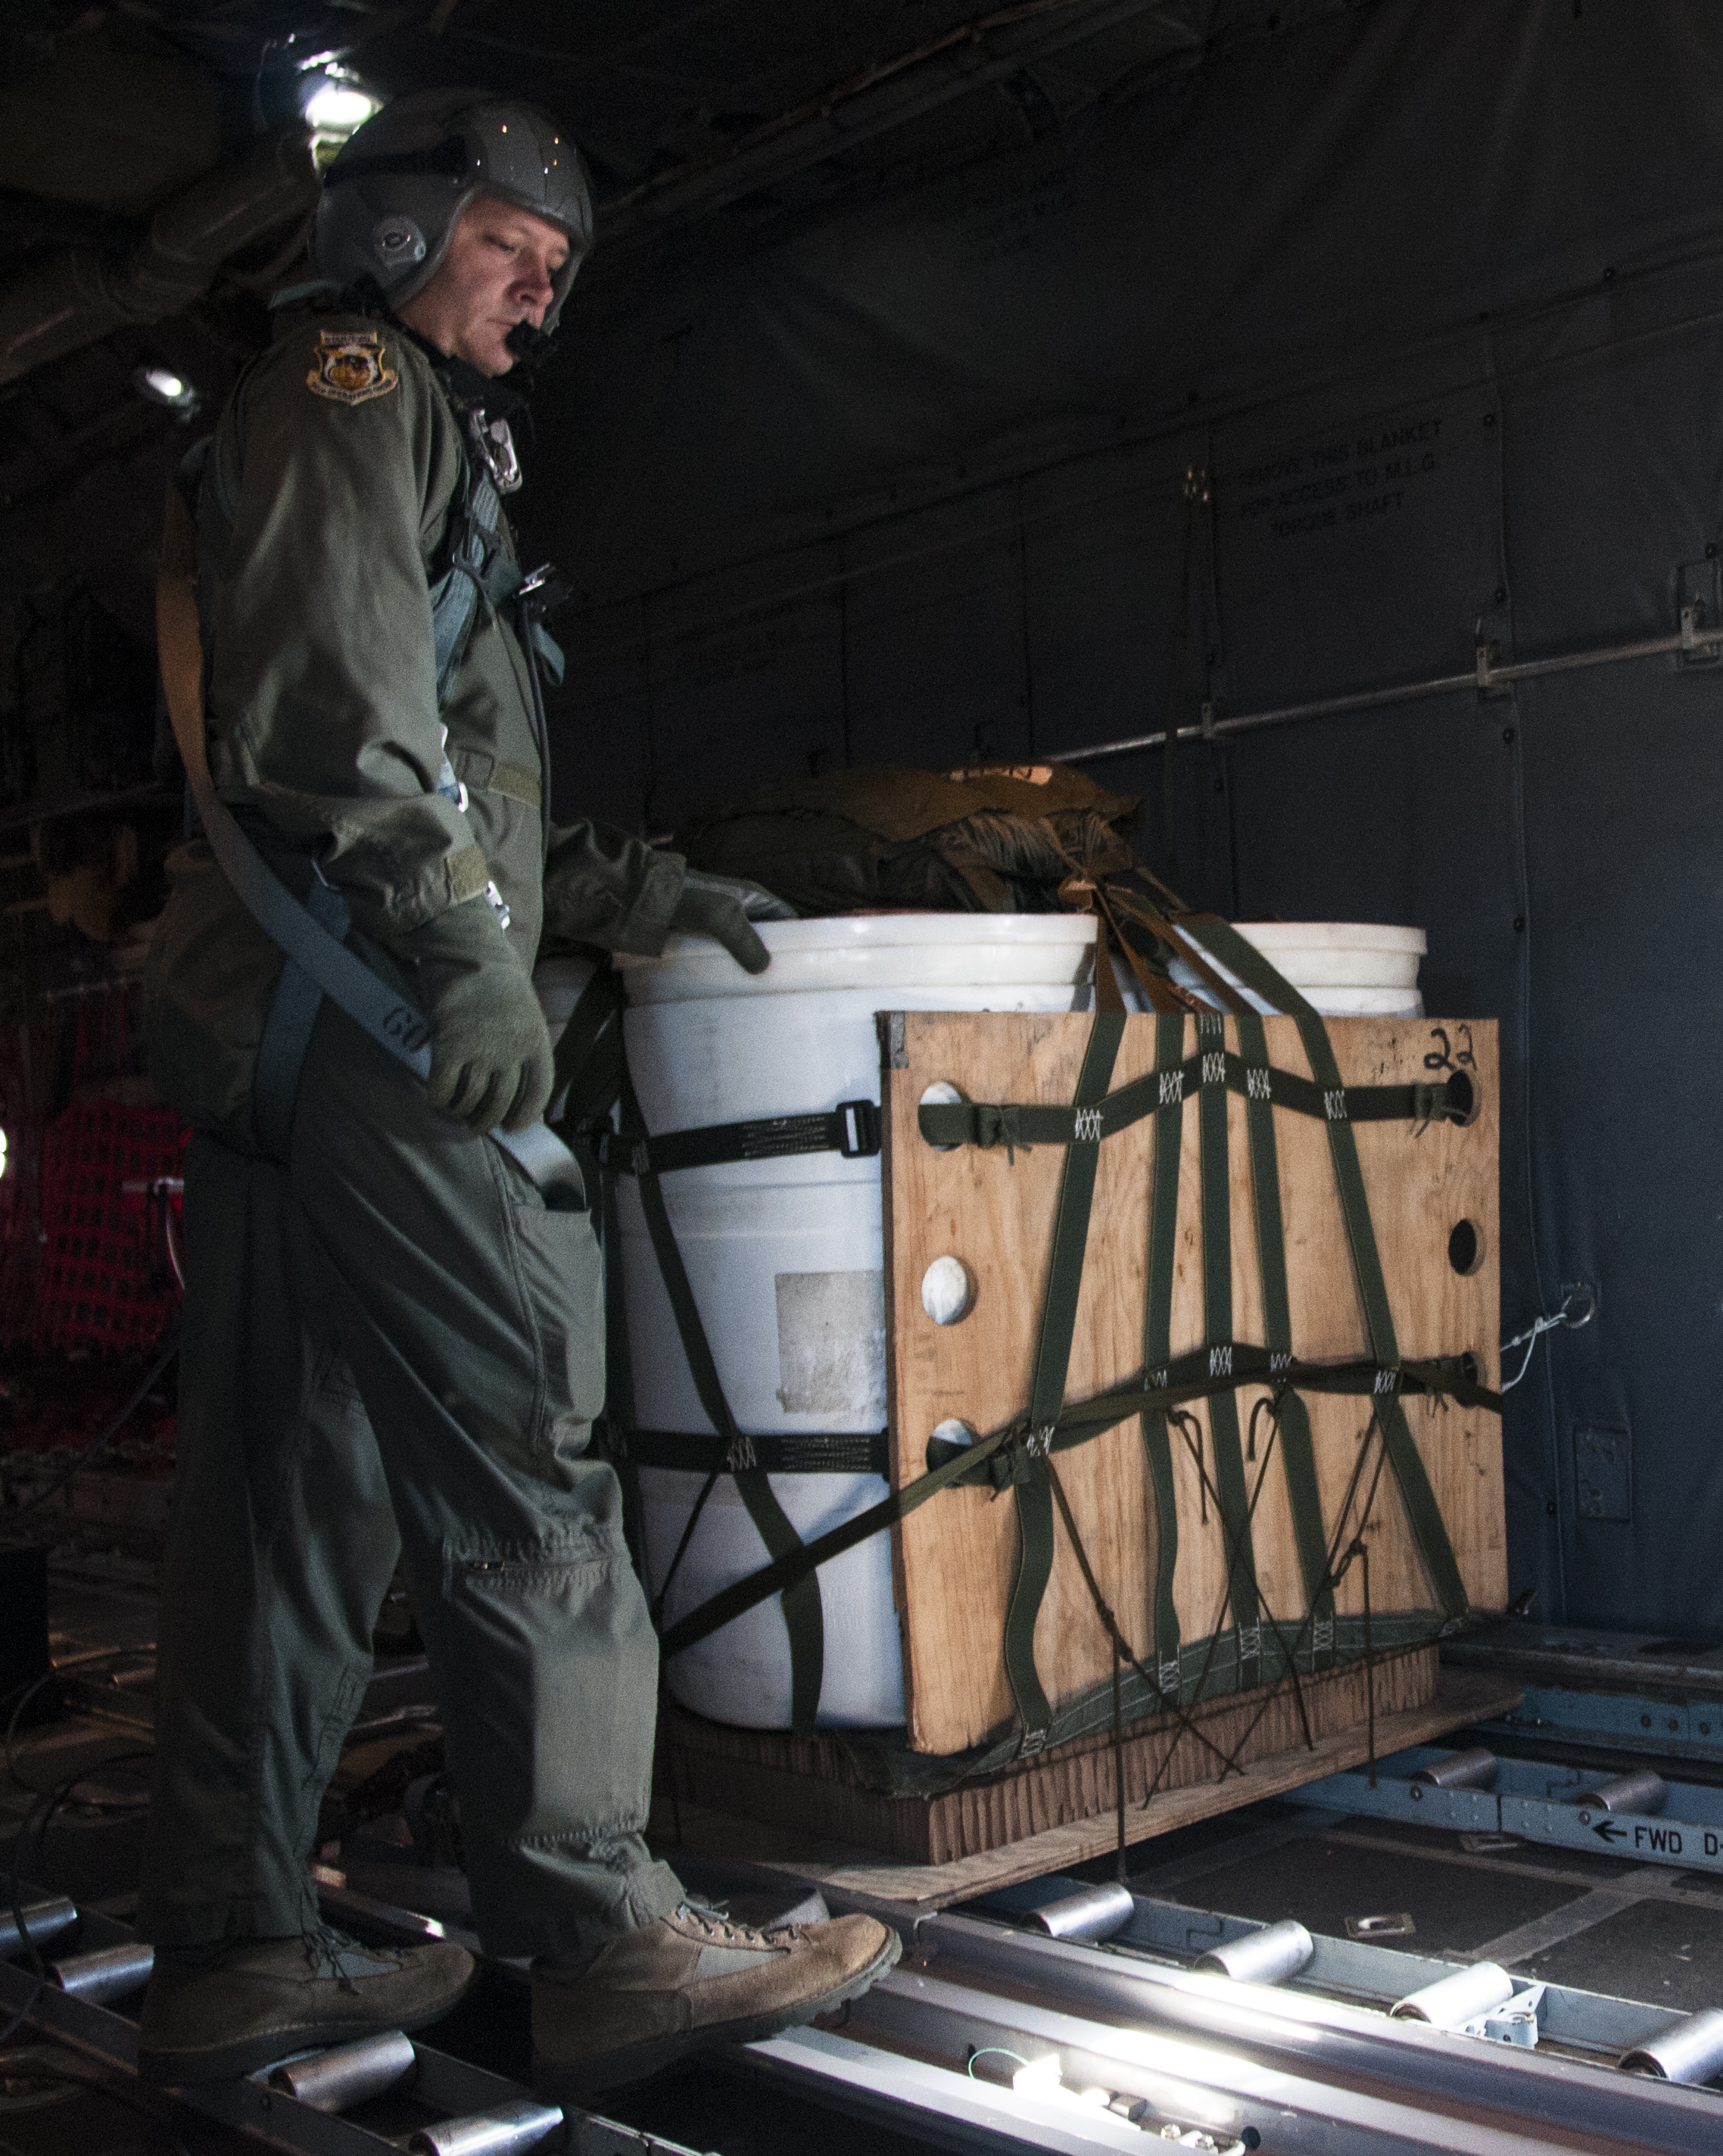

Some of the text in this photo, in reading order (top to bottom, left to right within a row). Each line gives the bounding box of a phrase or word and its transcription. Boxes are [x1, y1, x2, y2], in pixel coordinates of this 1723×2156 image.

[1310, 444, 1351, 469] THIS
[1357, 419, 1443, 456] BLANKET
[1240, 496, 1273, 519] FOR
[1279, 475, 1348, 505] ACCESS
[1355, 467, 1378, 486] TO
[1346, 491, 1404, 521] SHAFT
[1423, 1023, 1478, 1071] 22
[1634, 1826, 1682, 1853] FWD
